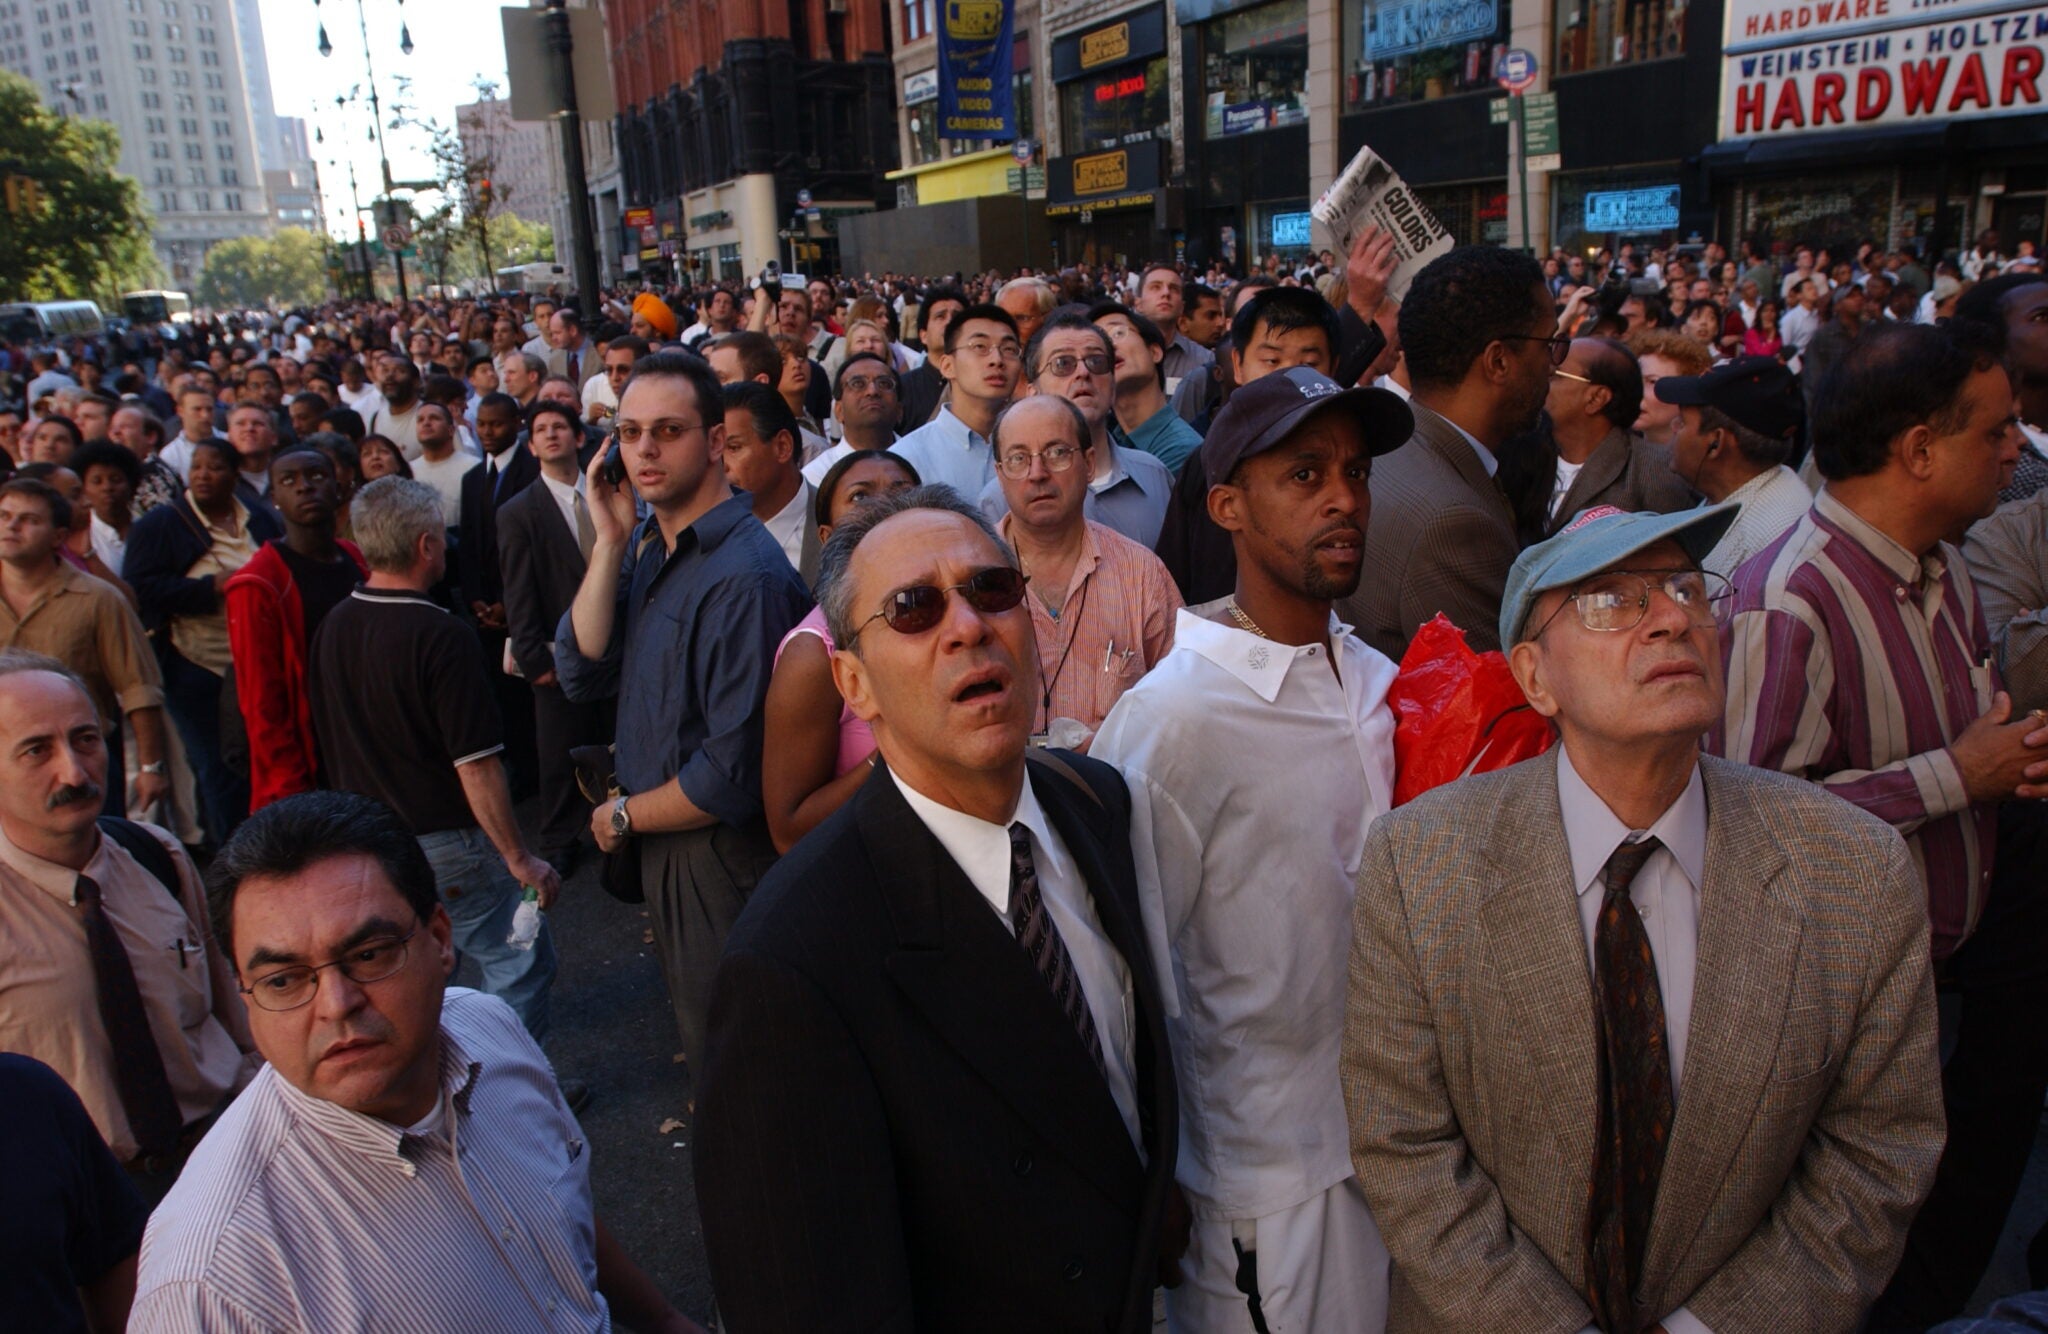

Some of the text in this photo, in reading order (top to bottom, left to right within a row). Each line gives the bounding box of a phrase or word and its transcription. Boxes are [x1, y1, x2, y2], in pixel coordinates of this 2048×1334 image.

[1746, 0, 1889, 36] HARDWARE
[1741, 37, 1889, 78] WEINSTEIN
[957, 77, 992, 91] AUDIO
[1735, 45, 2045, 134] HARDWAR
[957, 97, 992, 111] VIDEO
[946, 116, 1004, 131] CAMERAS
[1046, 203, 1073, 216] LATIN
[1118, 193, 1153, 207] MUSIC
[1383, 186, 1433, 253] COLORS
